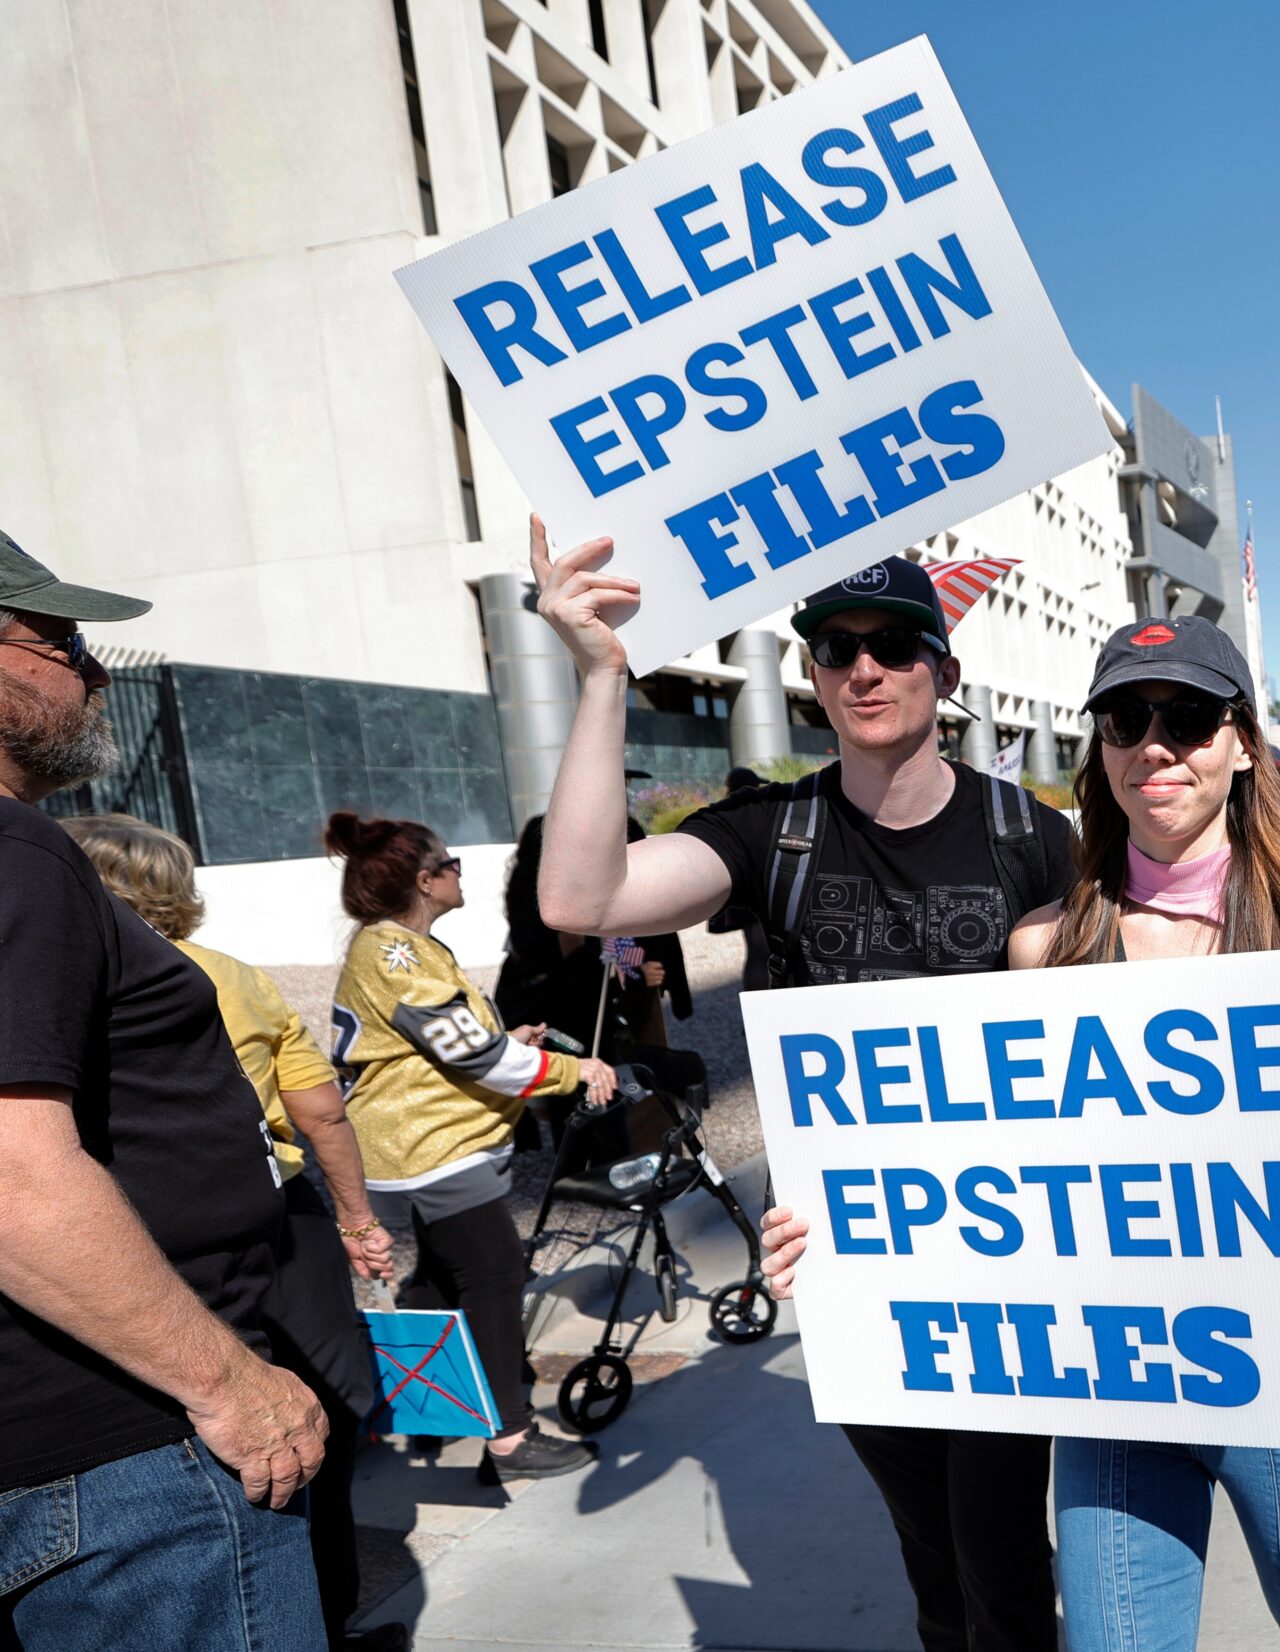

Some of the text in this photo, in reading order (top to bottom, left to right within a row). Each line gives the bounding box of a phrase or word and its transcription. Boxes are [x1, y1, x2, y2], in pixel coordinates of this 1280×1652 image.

[455, 93, 956, 386] RELEASE
[550, 234, 992, 498] EPSTEIN
[664, 380, 1005, 599] FILES
[421, 1007, 491, 1062] 29
[890, 1301, 1261, 1407] FILES
